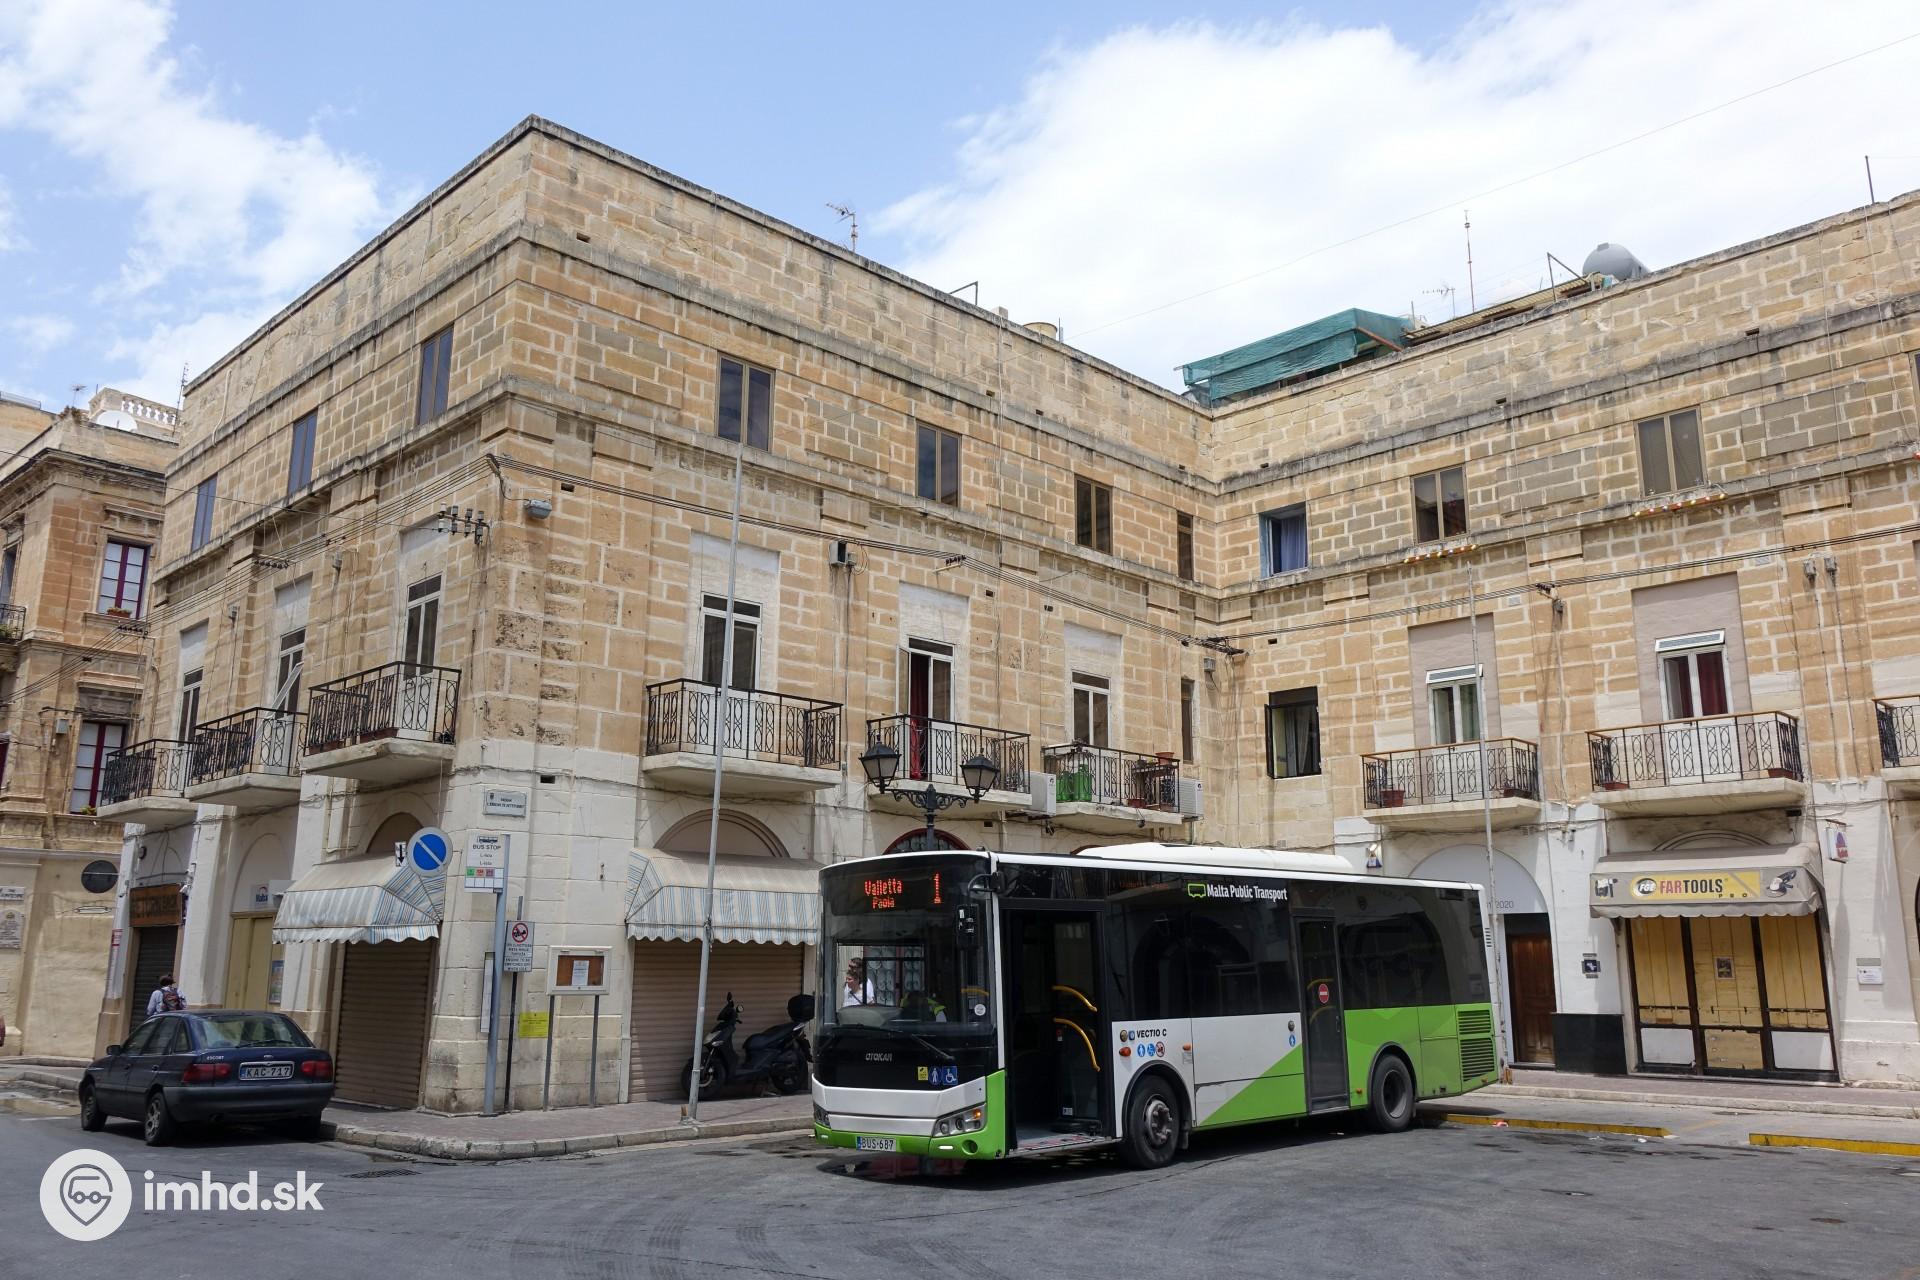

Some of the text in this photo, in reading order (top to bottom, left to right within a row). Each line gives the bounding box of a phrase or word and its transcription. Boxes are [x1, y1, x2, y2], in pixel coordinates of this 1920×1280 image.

[864, 873, 941, 904] Valletta 1
[1206, 884, 1288, 902] Malta Public Transport
[1660, 878, 1724, 894] FARTOOLS
[872, 897, 895, 909] Paola
[1495, 900, 1514, 909] 2020
[1136, 1028, 1167, 1039] VECTIO C
